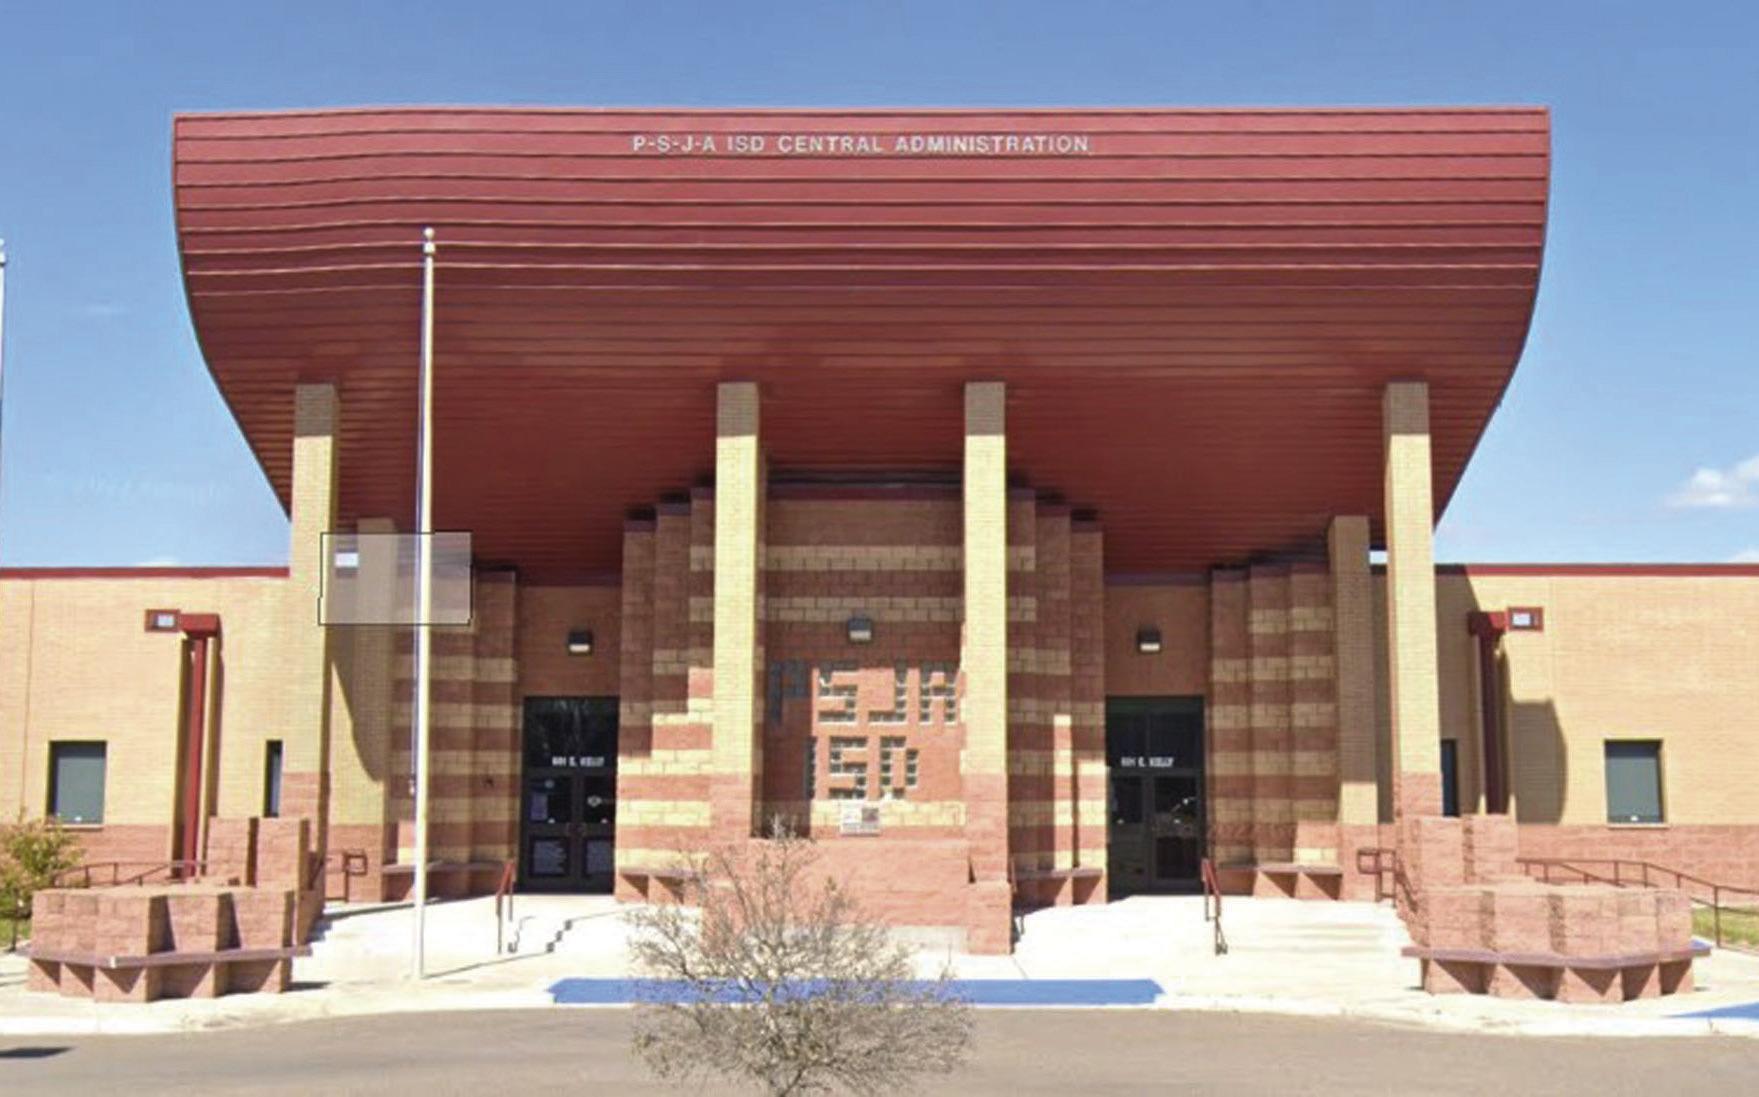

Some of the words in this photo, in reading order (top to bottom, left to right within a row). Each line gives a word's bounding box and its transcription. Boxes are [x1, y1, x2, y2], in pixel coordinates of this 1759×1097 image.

[633, 135, 716, 152] P-S-J-A
[727, 135, 765, 152] ISD
[777, 135, 883, 152] CENTRAL
[895, 135, 1089, 152] ADMINISTRATION
[769, 661, 957, 728] PSJA
[804, 736, 918, 799] ISD
